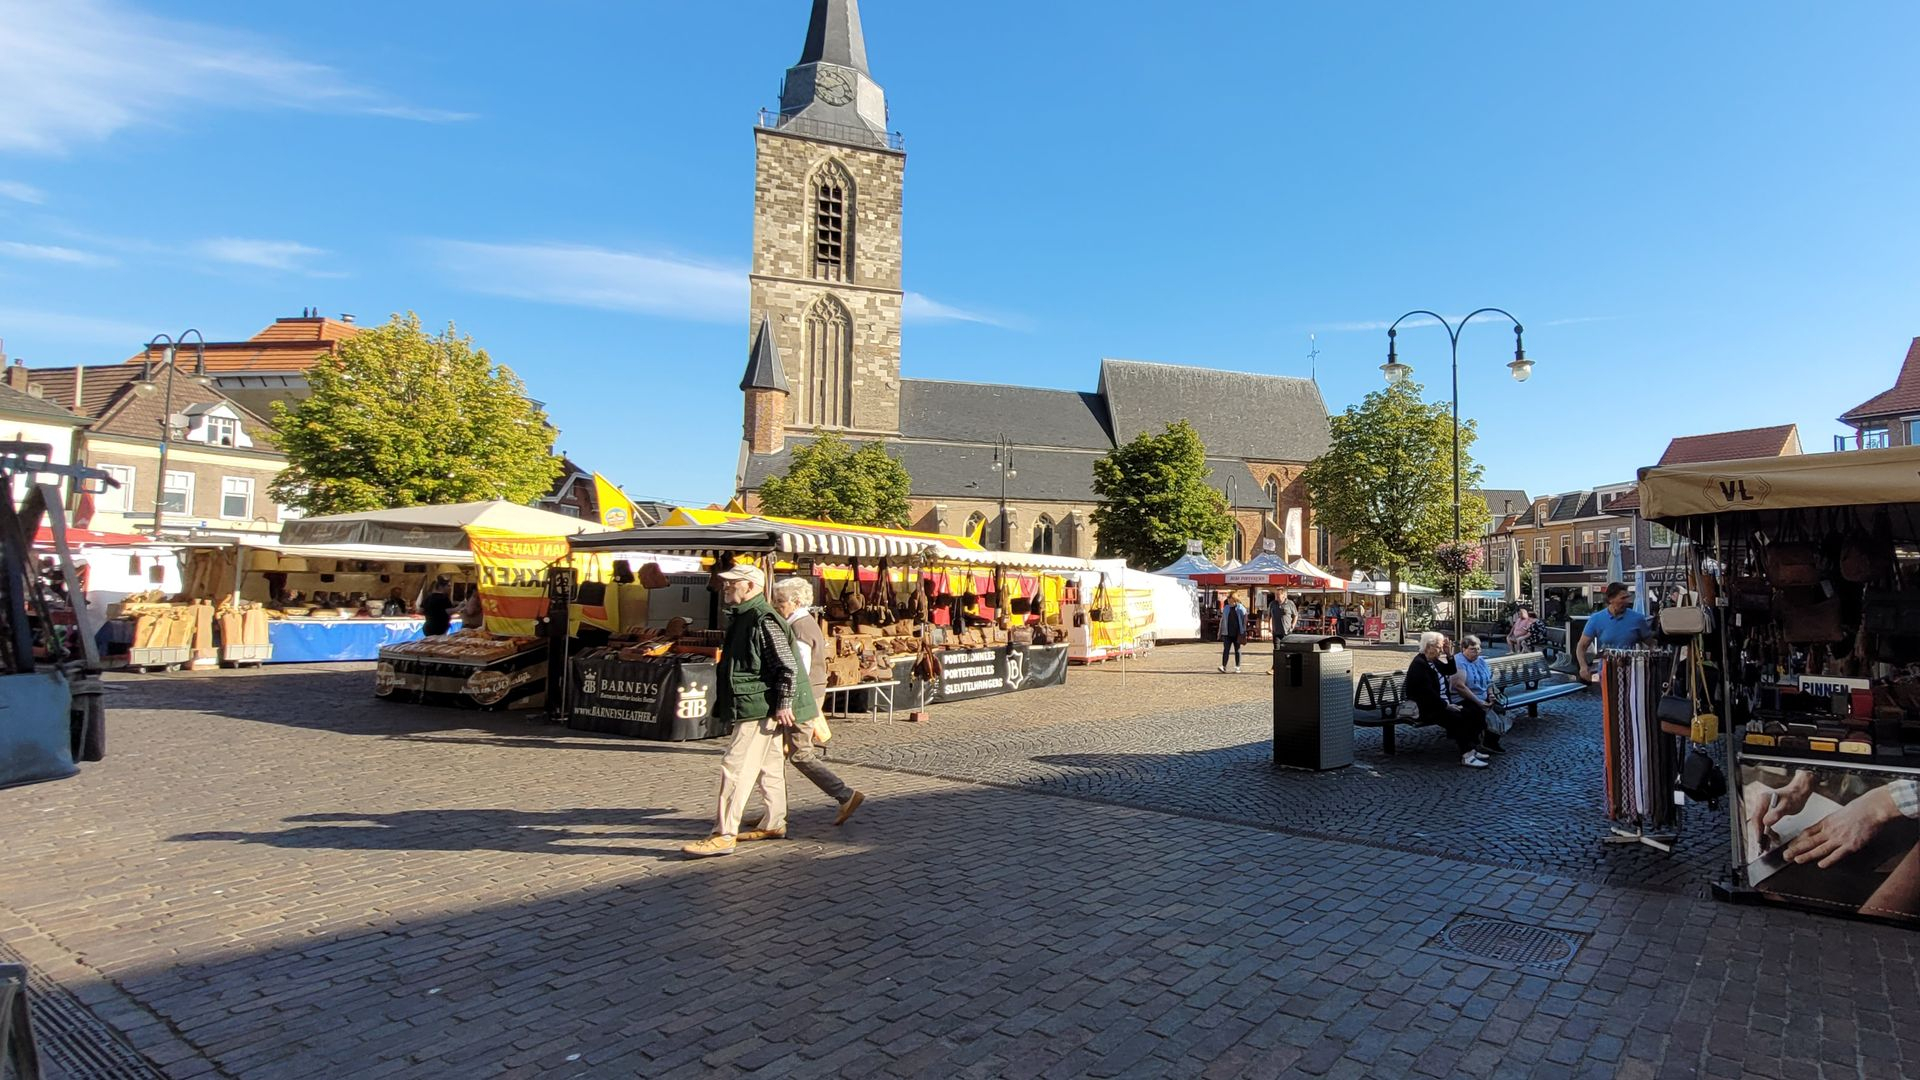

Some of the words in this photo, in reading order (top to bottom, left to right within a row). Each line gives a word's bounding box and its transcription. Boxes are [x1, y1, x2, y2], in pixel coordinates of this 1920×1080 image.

[1719, 480, 1754, 502] VL
[944, 665, 995, 679] PORTEFEUILLES
[601, 680, 658, 695] BARNEYS
[945, 678, 1003, 694] SLEUTELHANGERS
[1802, 682, 1849, 697] PINNEN
